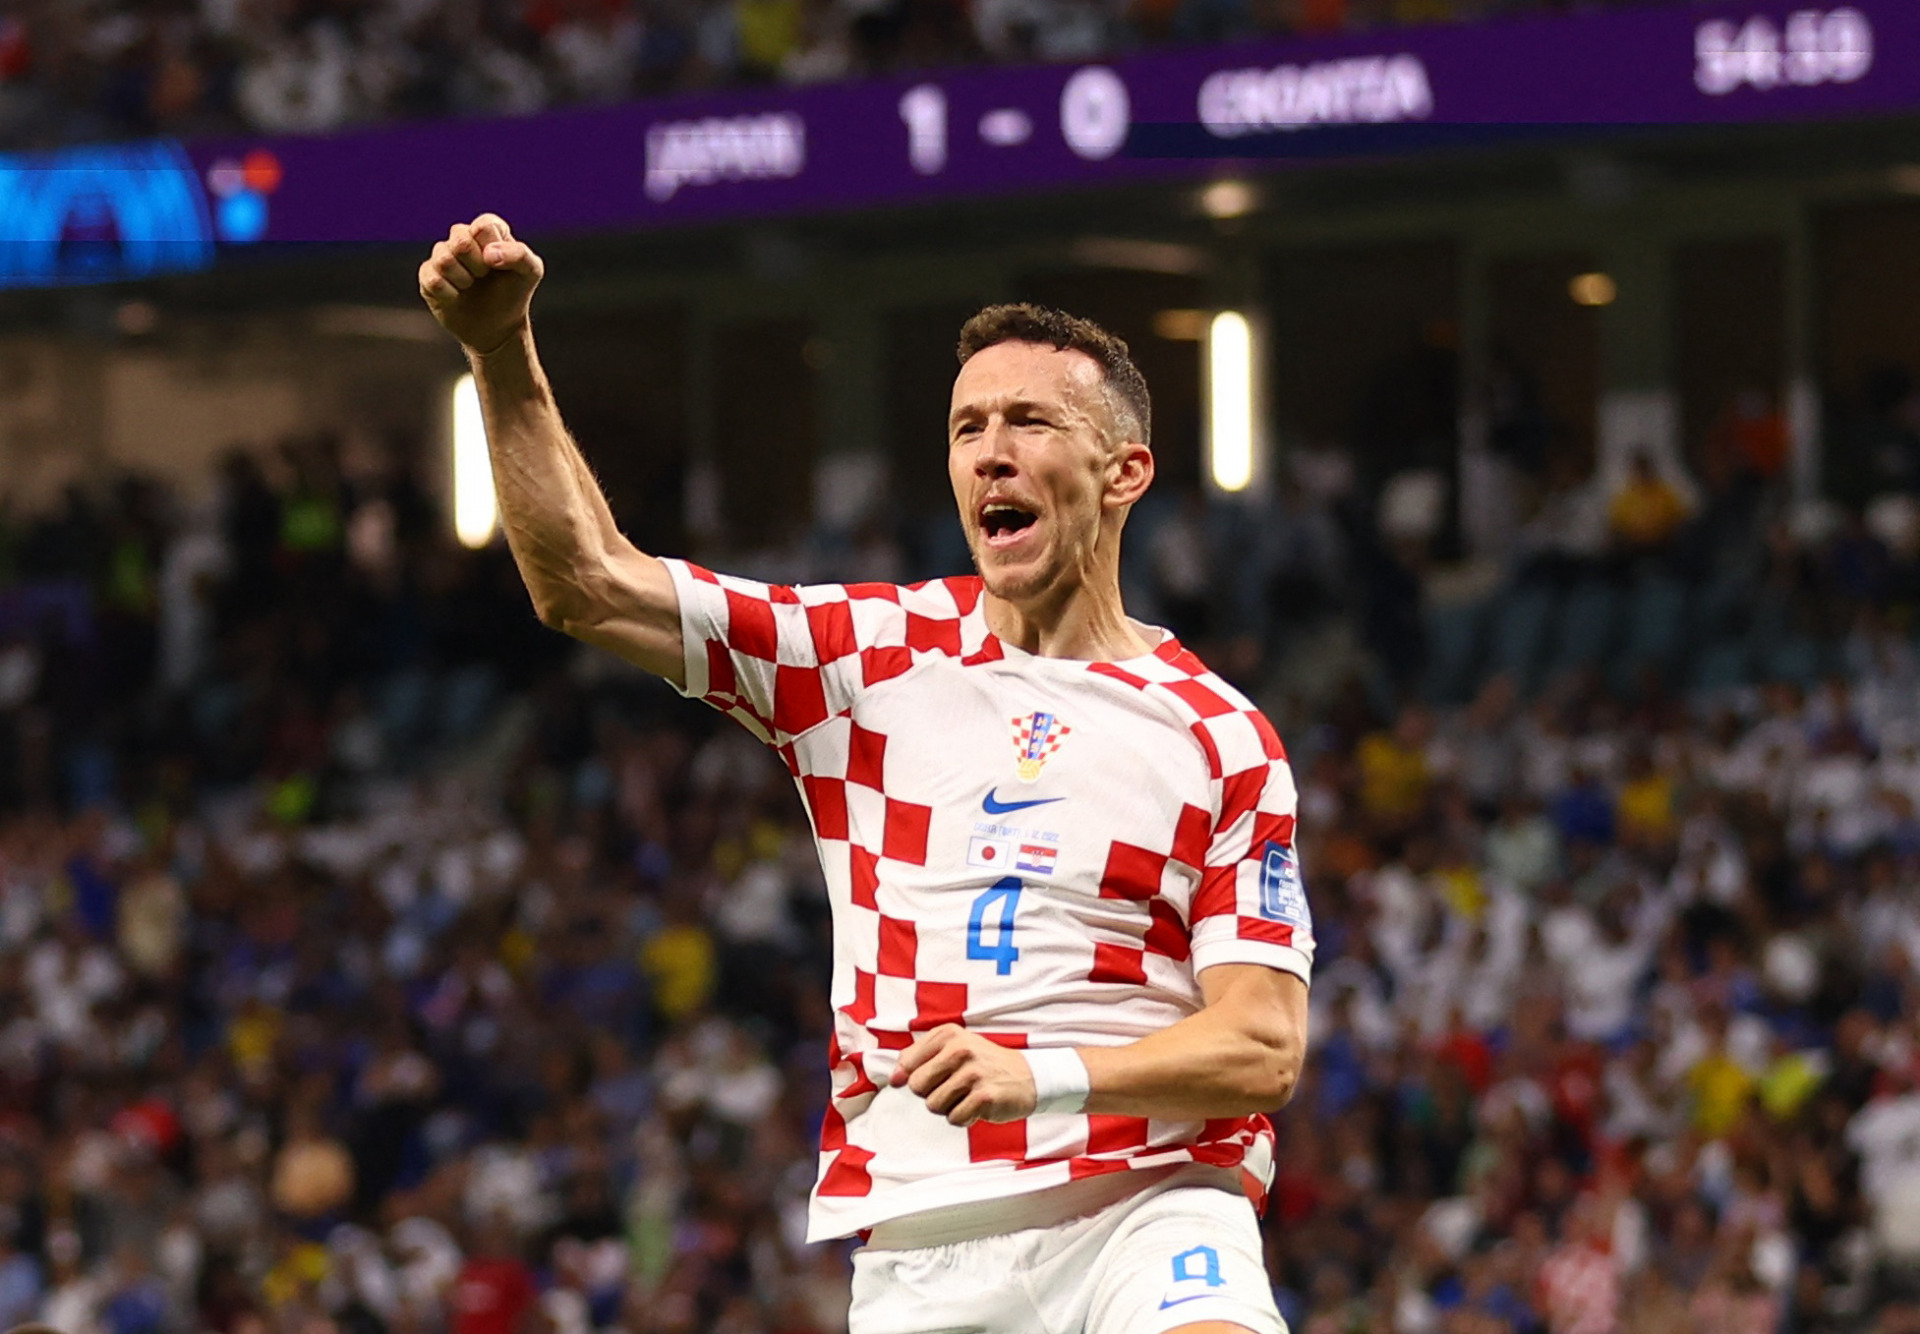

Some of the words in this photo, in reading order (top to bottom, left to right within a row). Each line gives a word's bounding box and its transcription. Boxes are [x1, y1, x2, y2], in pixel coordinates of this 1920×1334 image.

[899, 84, 947, 174] 1
[1060, 66, 1131, 161] 0
[966, 876, 1022, 975] 4
